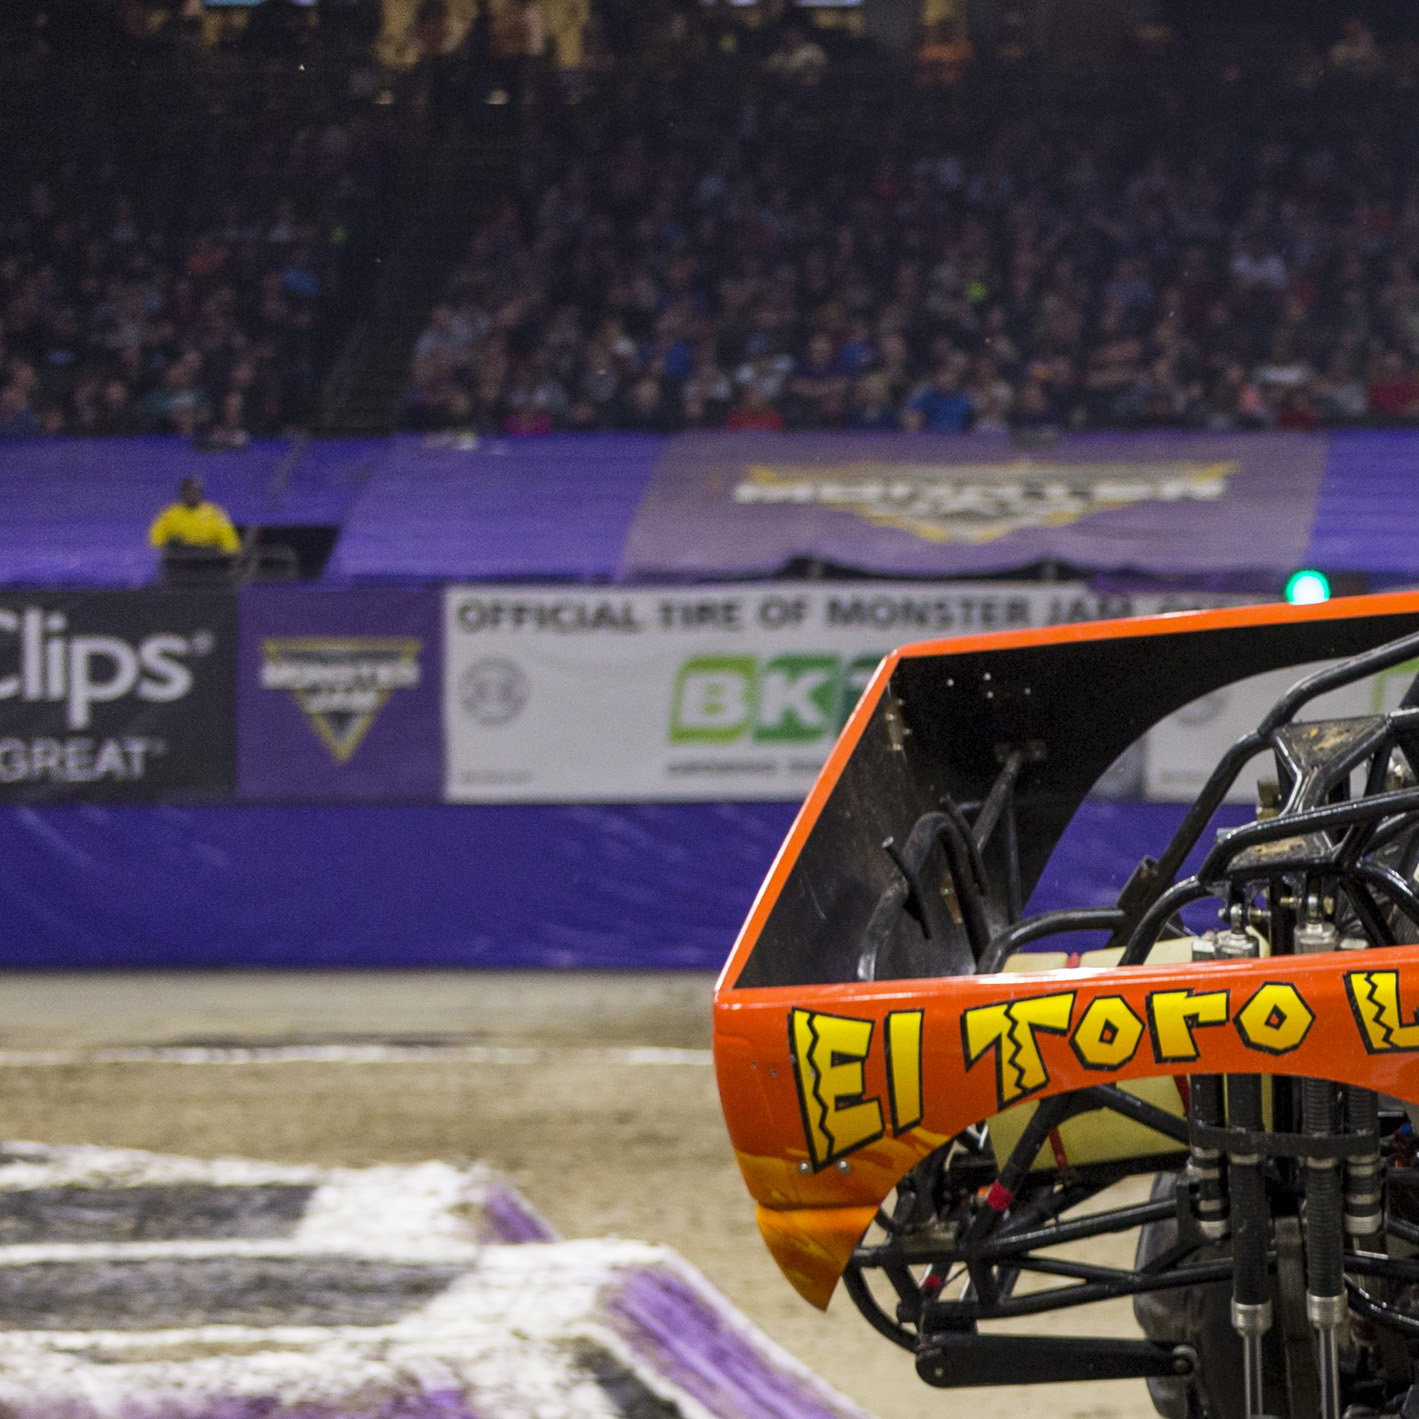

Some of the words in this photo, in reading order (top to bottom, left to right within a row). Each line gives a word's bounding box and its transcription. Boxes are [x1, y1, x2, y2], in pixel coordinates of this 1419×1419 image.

[456, 602, 645, 633] OFFICIAL
[660, 600, 746, 632] TIRE
[759, 598, 808, 631] OF
[827, 596, 1031, 630] MONSTER
[0, 606, 194, 729] lips
[668, 656, 868, 744] BK
